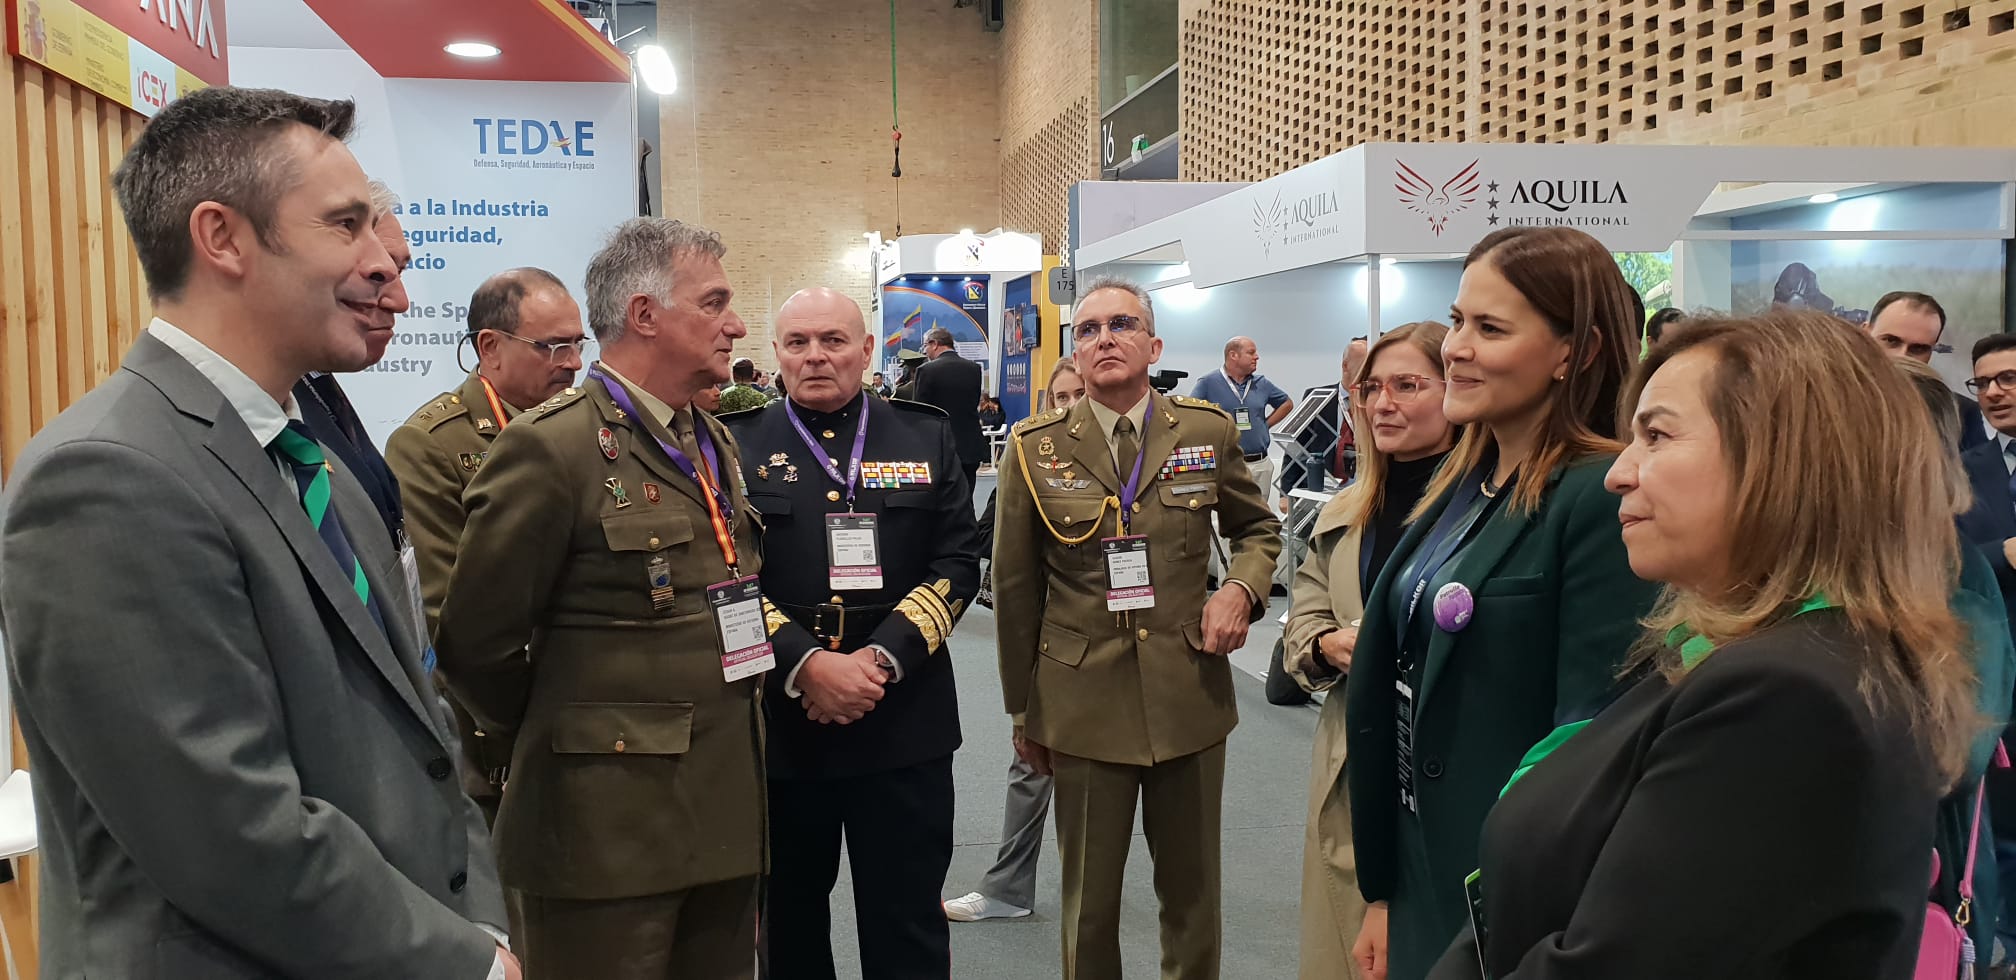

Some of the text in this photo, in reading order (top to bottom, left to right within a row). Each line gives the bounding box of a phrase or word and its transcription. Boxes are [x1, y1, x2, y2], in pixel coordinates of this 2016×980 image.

[1102, 120, 1115, 167] 16
[572, 161, 595, 171] Espacio
[1509, 179, 1629, 212] AQUILA
[409, 202, 421, 215] a
[427, 198, 446, 216] la
[452, 199, 549, 217] Industria
[1291, 189, 1339, 227] AQUILA
[1508, 216, 1630, 226] INTERNATIONAL
[402, 226, 503, 246] eguridad,
[1290, 223, 1340, 246] INTERNATIONAL
[1061, 268, 1068, 279] E
[1056, 280, 1075, 291] 175
